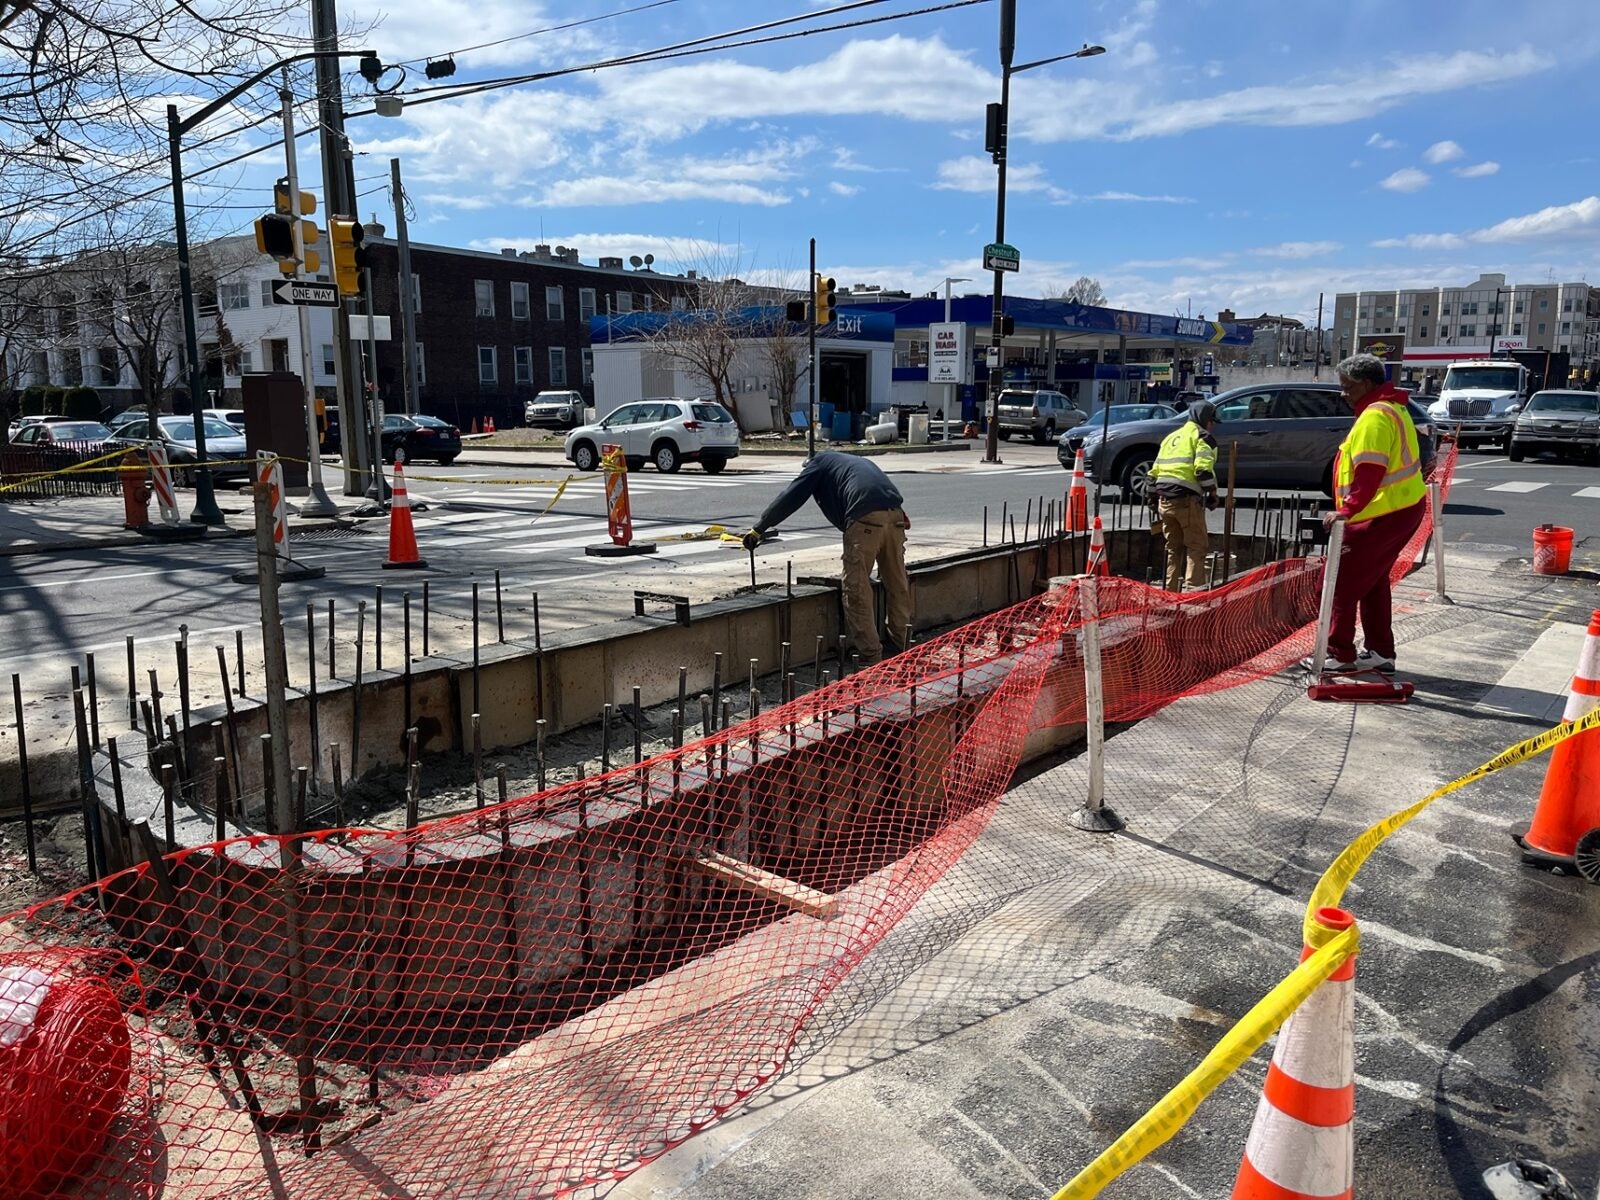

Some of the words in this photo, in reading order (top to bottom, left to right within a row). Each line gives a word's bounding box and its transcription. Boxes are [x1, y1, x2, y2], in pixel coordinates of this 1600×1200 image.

[987, 245, 1013, 258] Chestnut
[292, 287, 311, 299] ONE
[313, 289, 332, 300] WAY
[837, 313, 862, 333] Exit
[1177, 319, 1206, 336] SUNOCO
[937, 332, 954, 340] CAR
[935, 341, 957, 349] WASH
[1498, 340, 1523, 349] Exxon
